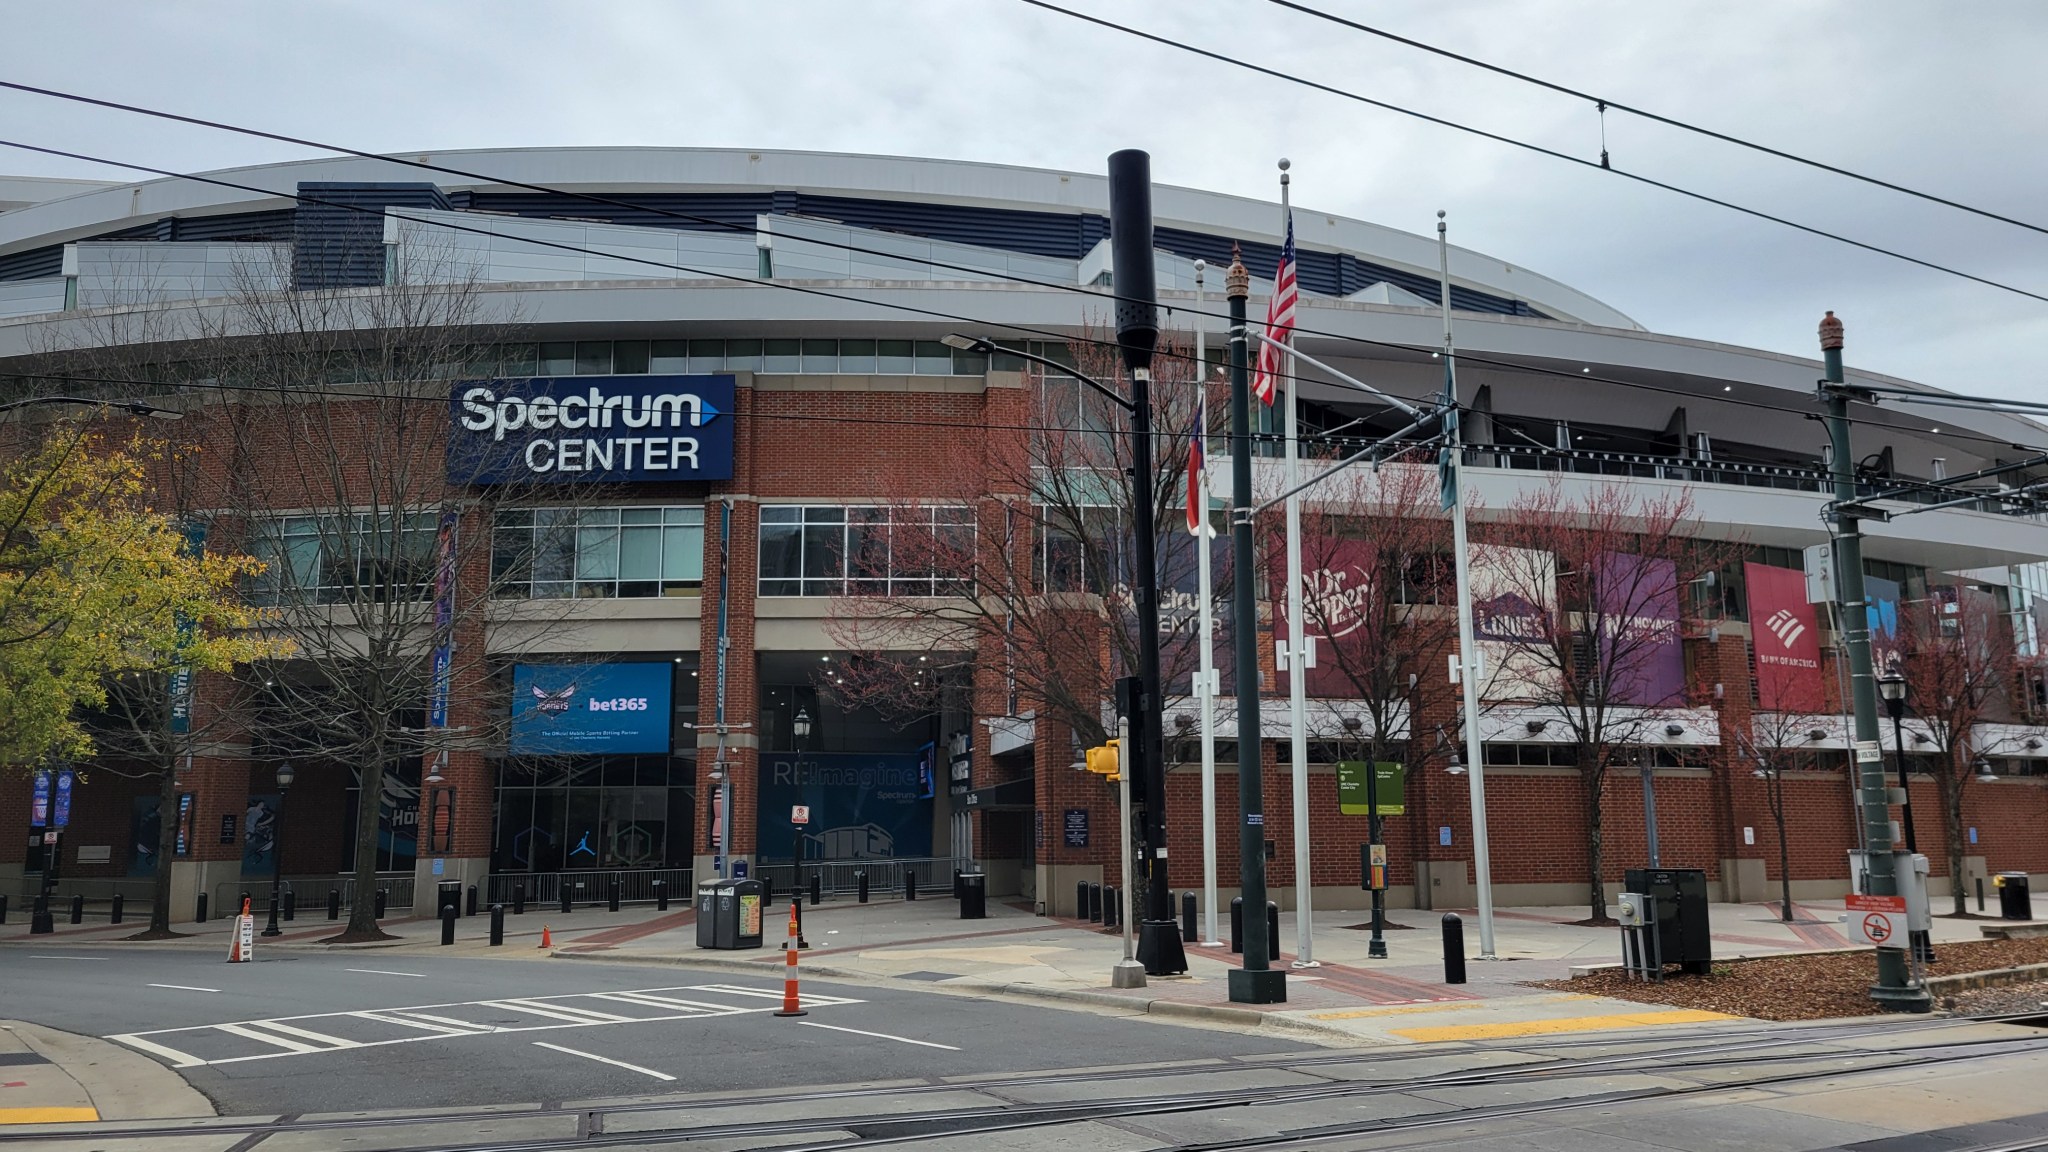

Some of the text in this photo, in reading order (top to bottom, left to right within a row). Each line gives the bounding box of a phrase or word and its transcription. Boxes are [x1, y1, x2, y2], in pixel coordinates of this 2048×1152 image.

[461, 387, 702, 441] Spectrum
[525, 436, 699, 472] CENTER
[1760, 655, 1818, 669] BANK OF AMERICA
[589, 698, 648, 711] bet365
[877, 791, 912, 801] Spectrum
